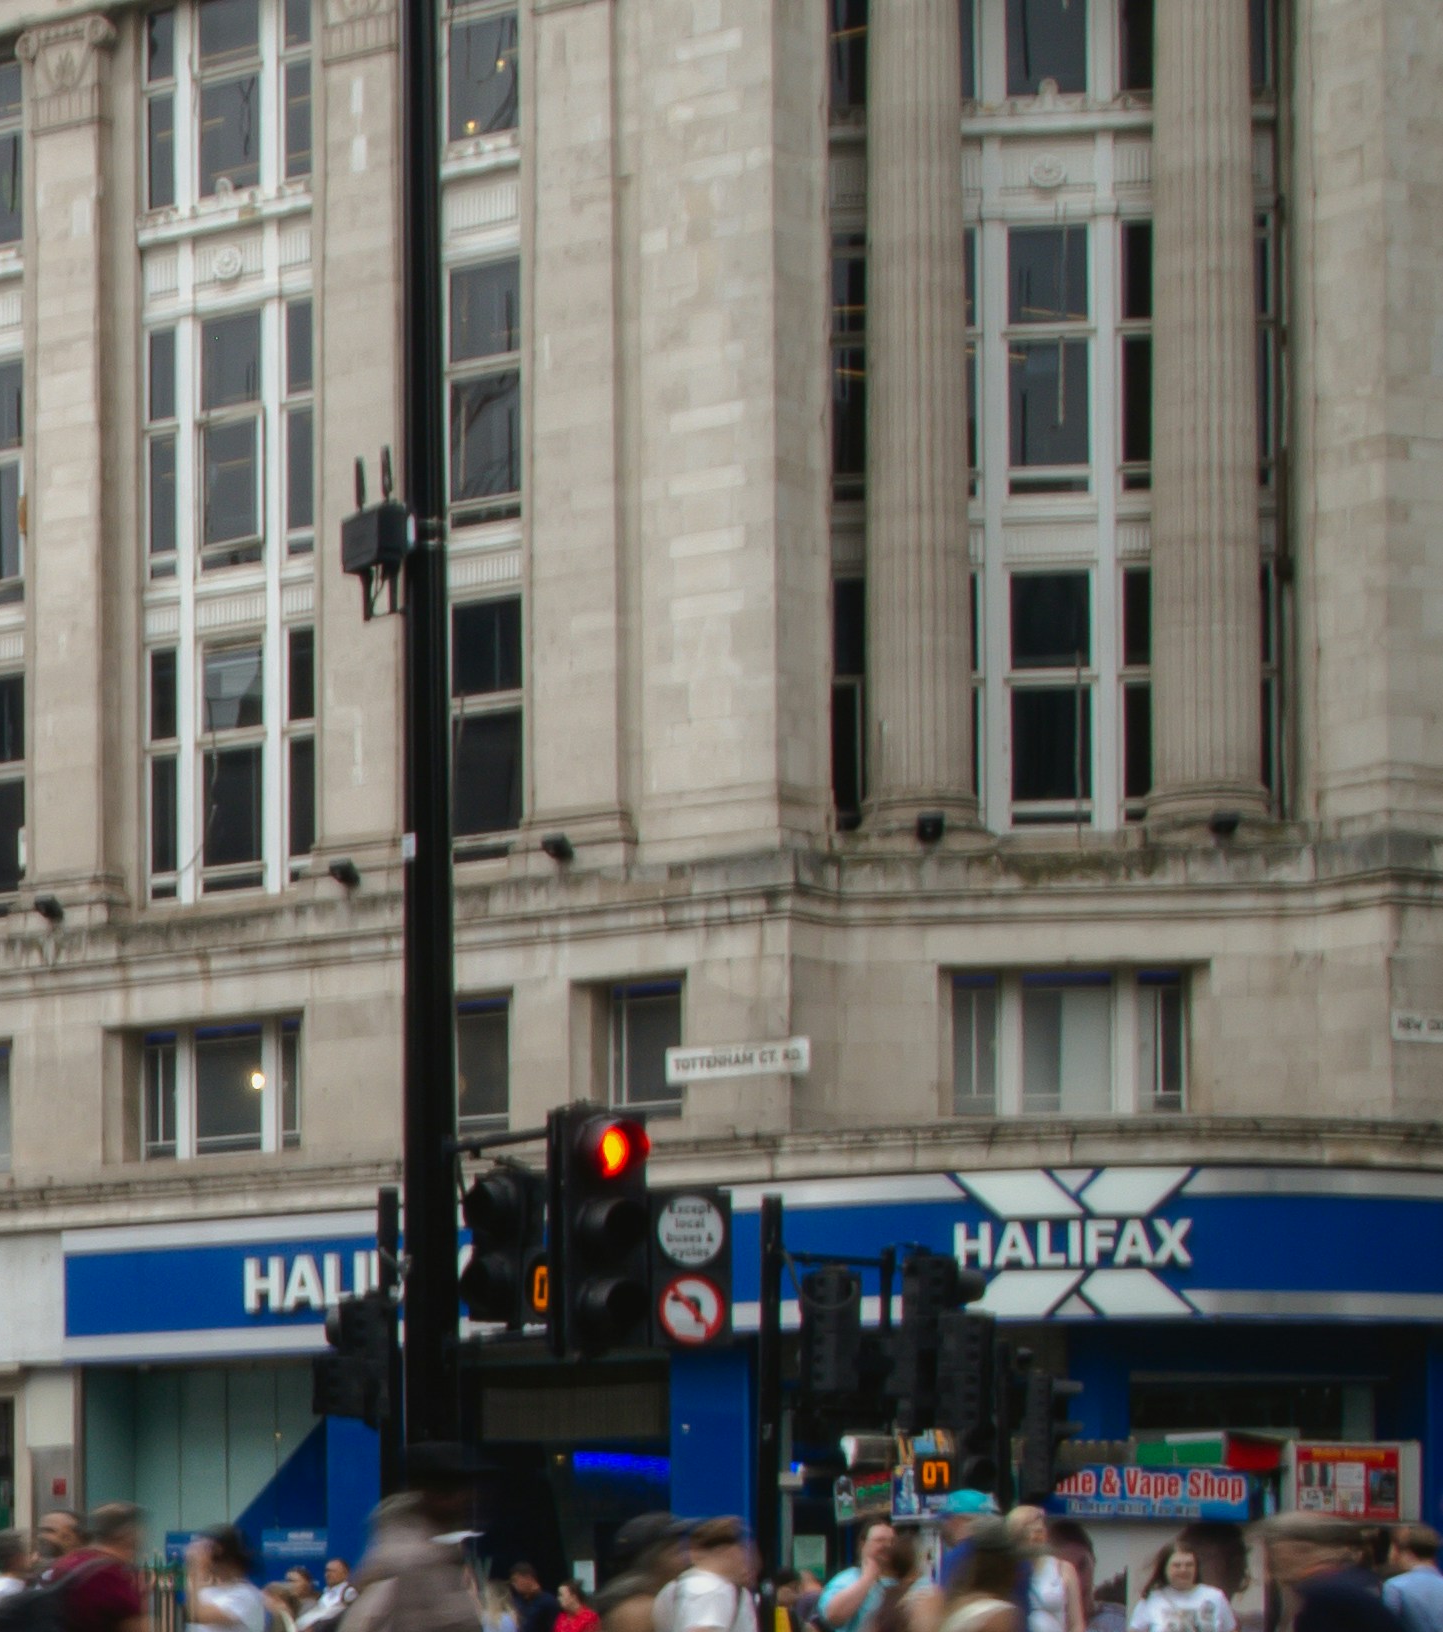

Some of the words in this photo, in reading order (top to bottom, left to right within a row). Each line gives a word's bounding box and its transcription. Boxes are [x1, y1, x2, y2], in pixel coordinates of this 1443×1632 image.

[674, 1050, 754, 1072] TOTTENHAM
[668, 1200, 713, 1216] Except
[674, 1217, 707, 1230] local
[665, 1232, 703, 1244] buses
[953, 1218, 1193, 1270] HALIFAX
[670, 1246, 710, 1259] cycles
[922, 1460, 950, 1490] 07
[1100, 1467, 1120, 1495] &
[1126, 1468, 1182, 1500] Vape
[1187, 1471, 1245, 1502] Shop
